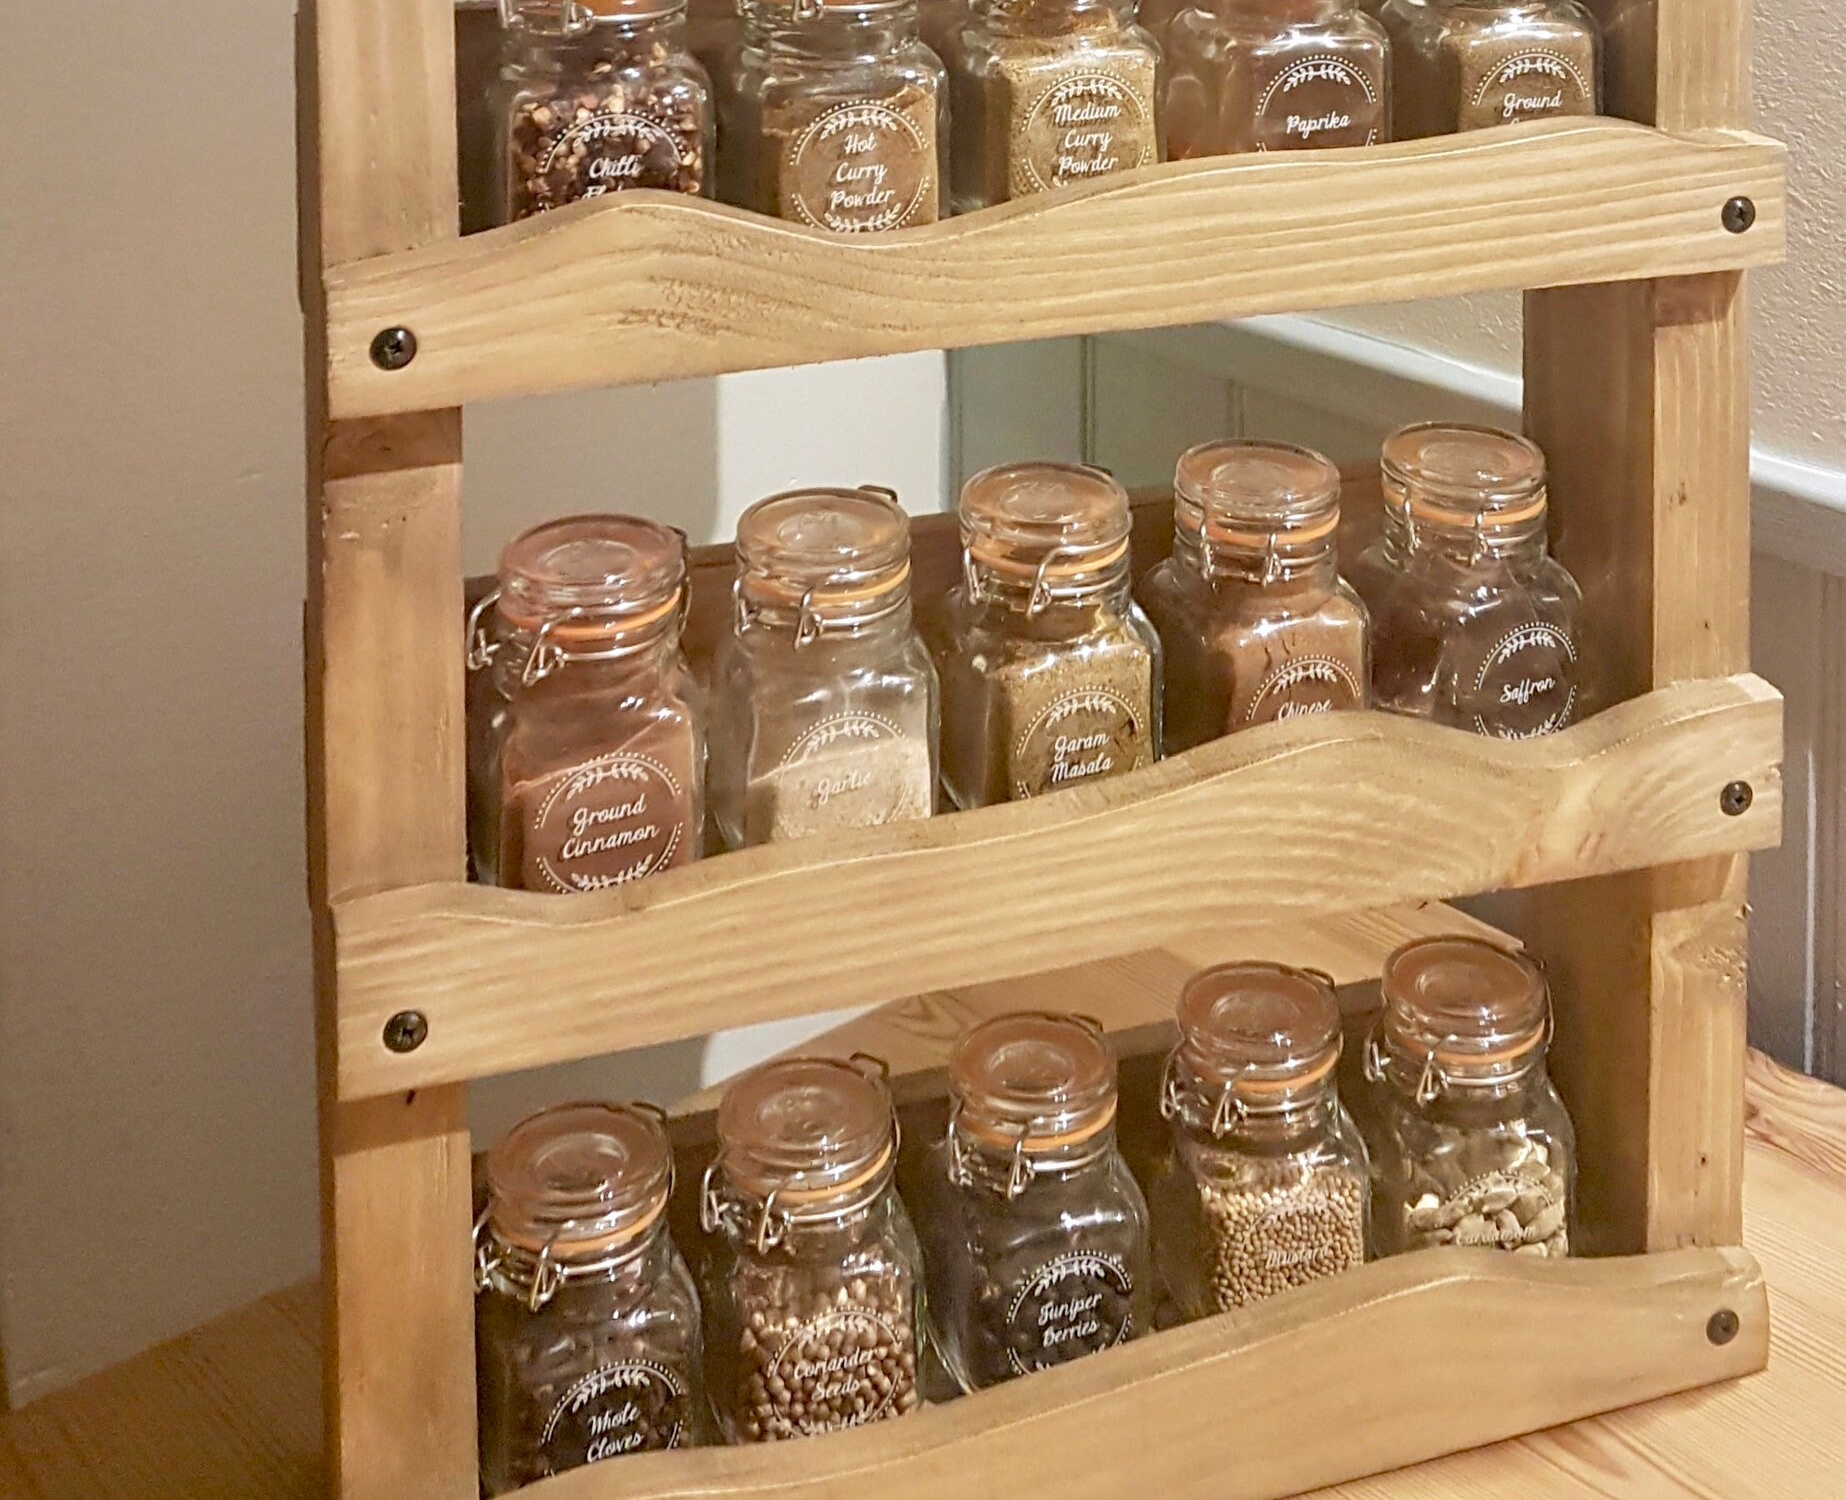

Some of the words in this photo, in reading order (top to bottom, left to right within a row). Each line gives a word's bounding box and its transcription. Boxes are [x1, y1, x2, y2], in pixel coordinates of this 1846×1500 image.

[1053, 102, 1121, 124] Medium
[1503, 89, 1563, 118] Ground
[1286, 110, 1351, 139] Paprika
[844, 132, 877, 154] Hot
[1064, 128, 1113, 152] Curry
[589, 155, 641, 179] Chilli
[835, 162, 888, 185] Curry
[1058, 153, 1119, 175] Powder
[830, 186, 895, 210] Powder
[1499, 677, 1556, 705] Saffron
[1278, 699, 1333, 722] Chinese
[1053, 732, 1110, 762] Garam
[1050, 752, 1114, 783] Masala
[817, 769, 872, 804] Garlic
[573, 793, 647, 836] Ground
[562, 824, 660, 860] Cinnamon
[1037, 1292, 1103, 1326] Juniper
[1042, 1319, 1098, 1348] Berries
[793, 1345, 878, 1380] Coriander
[811, 1373, 860, 1401] Seeds
[587, 1401, 640, 1436] Whole
[586, 1430, 645, 1463] Cloves
